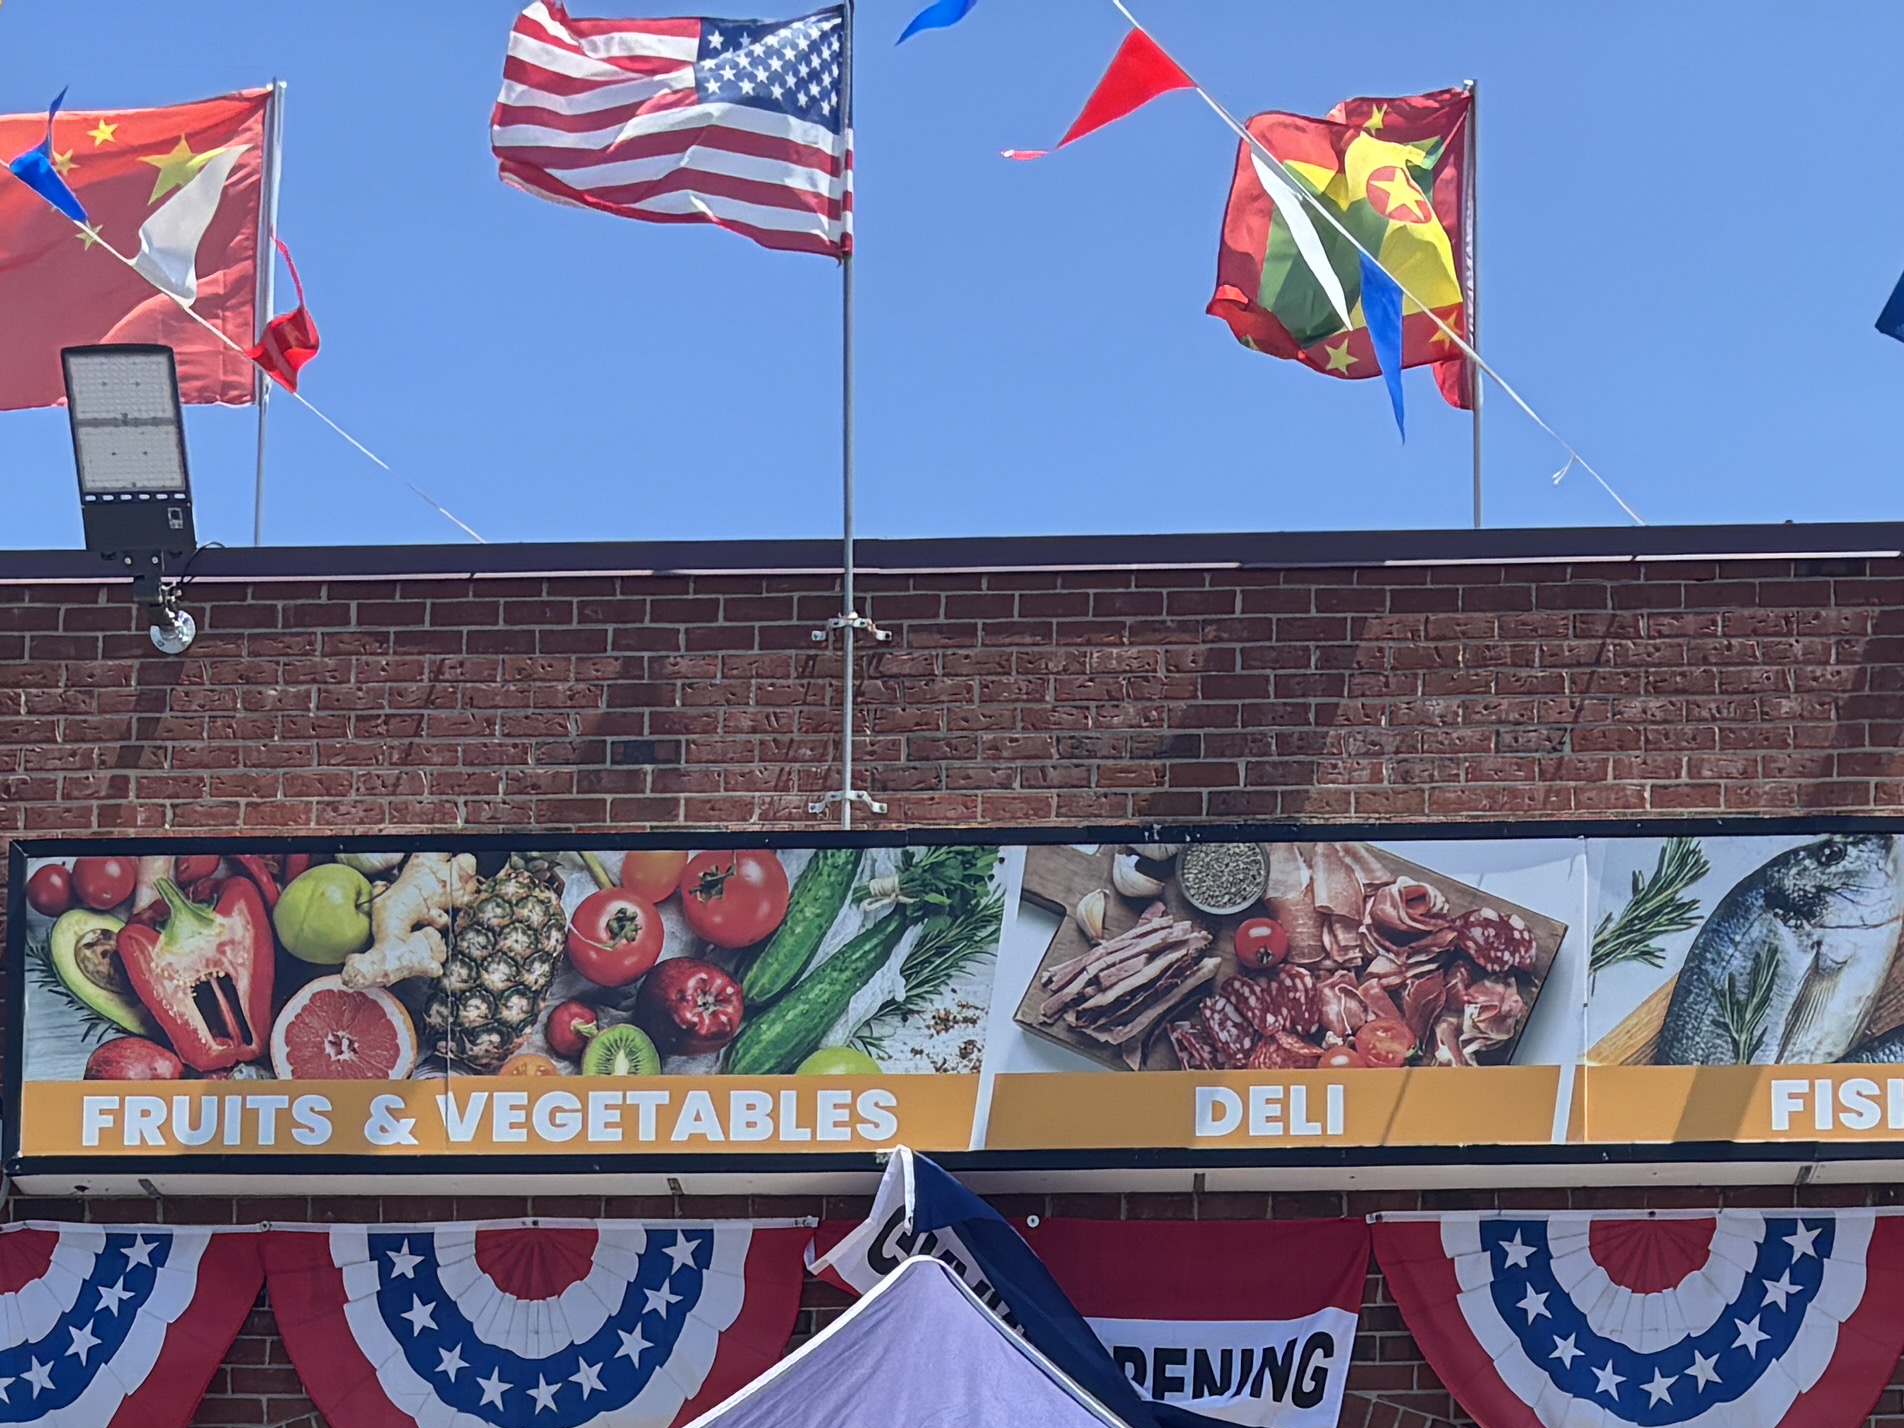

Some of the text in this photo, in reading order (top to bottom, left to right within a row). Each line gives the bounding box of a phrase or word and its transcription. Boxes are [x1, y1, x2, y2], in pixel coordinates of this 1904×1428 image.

[82, 1089, 897, 1146] FRUITS & VEGETABLES
[1195, 1084, 1344, 1138] DELI
[1113, 1331, 1335, 1409] PENING
